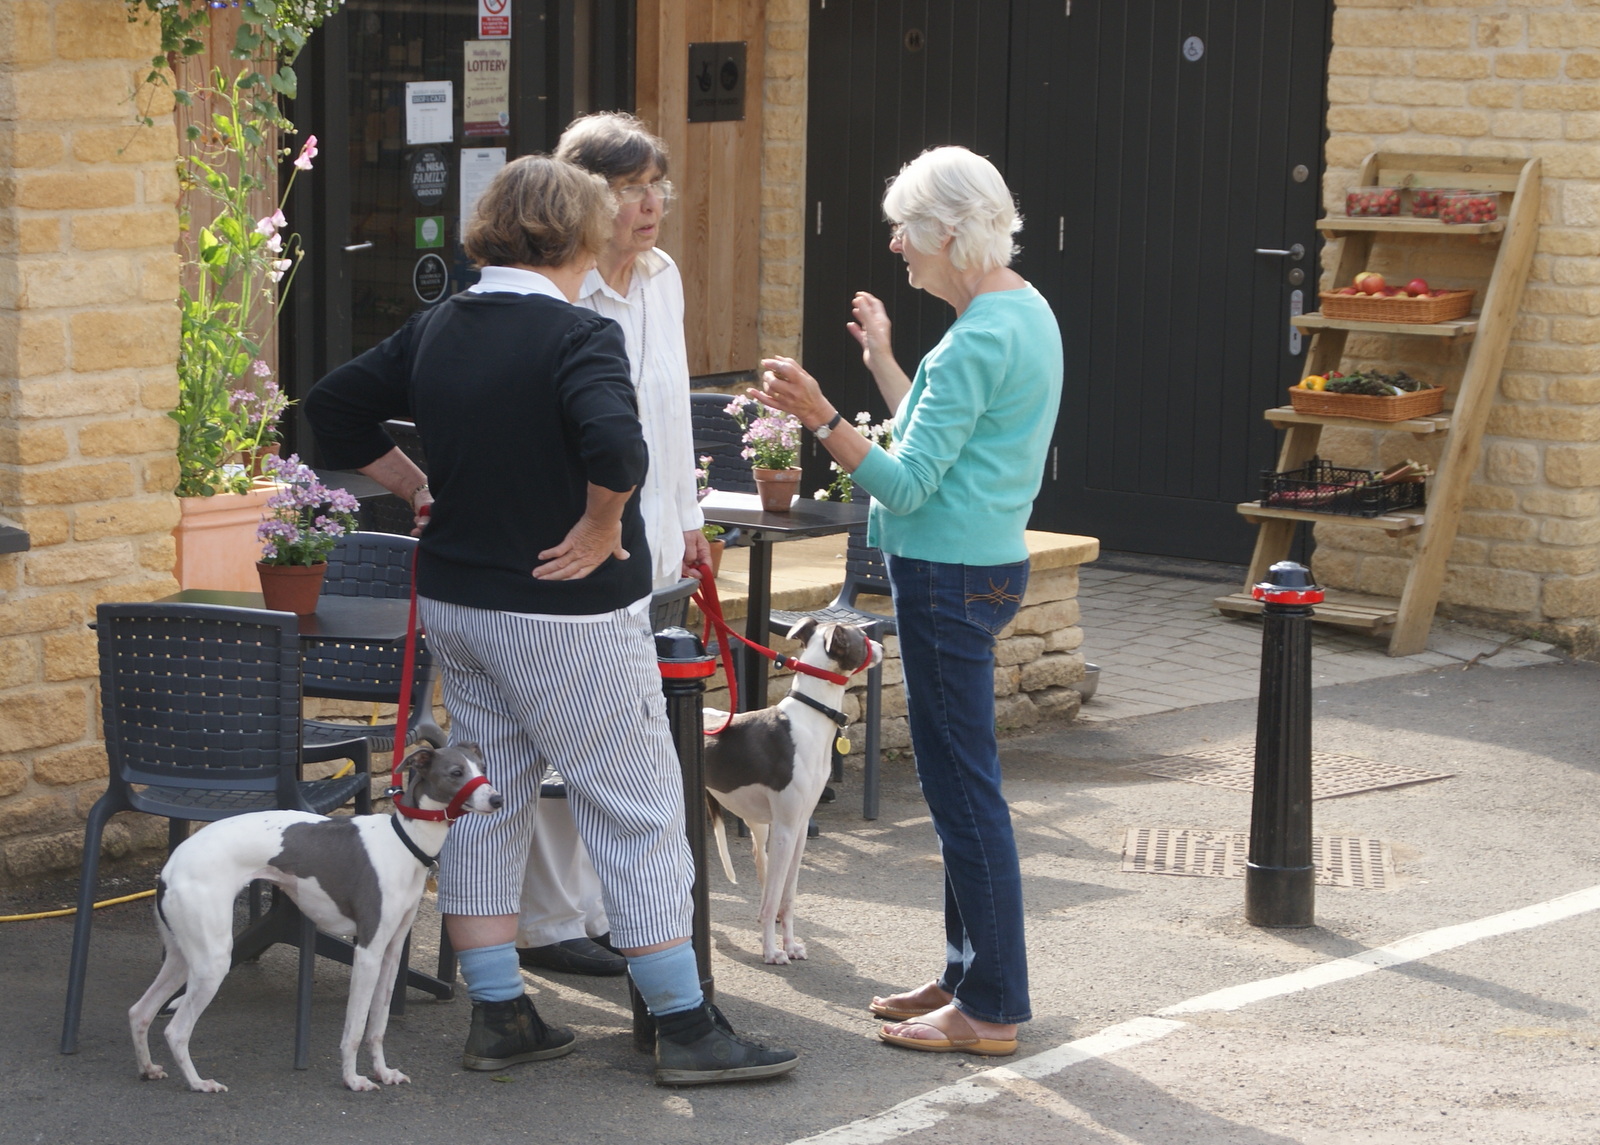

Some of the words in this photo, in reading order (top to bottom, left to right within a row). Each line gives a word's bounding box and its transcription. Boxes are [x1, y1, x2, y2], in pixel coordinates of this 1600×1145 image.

[467, 59, 508, 72] LOTTERY
[415, 162, 425, 172] the
[426, 161, 445, 172] NISA
[412, 171, 447, 183] FAMILY
[417, 189, 442, 197] GROCERS
